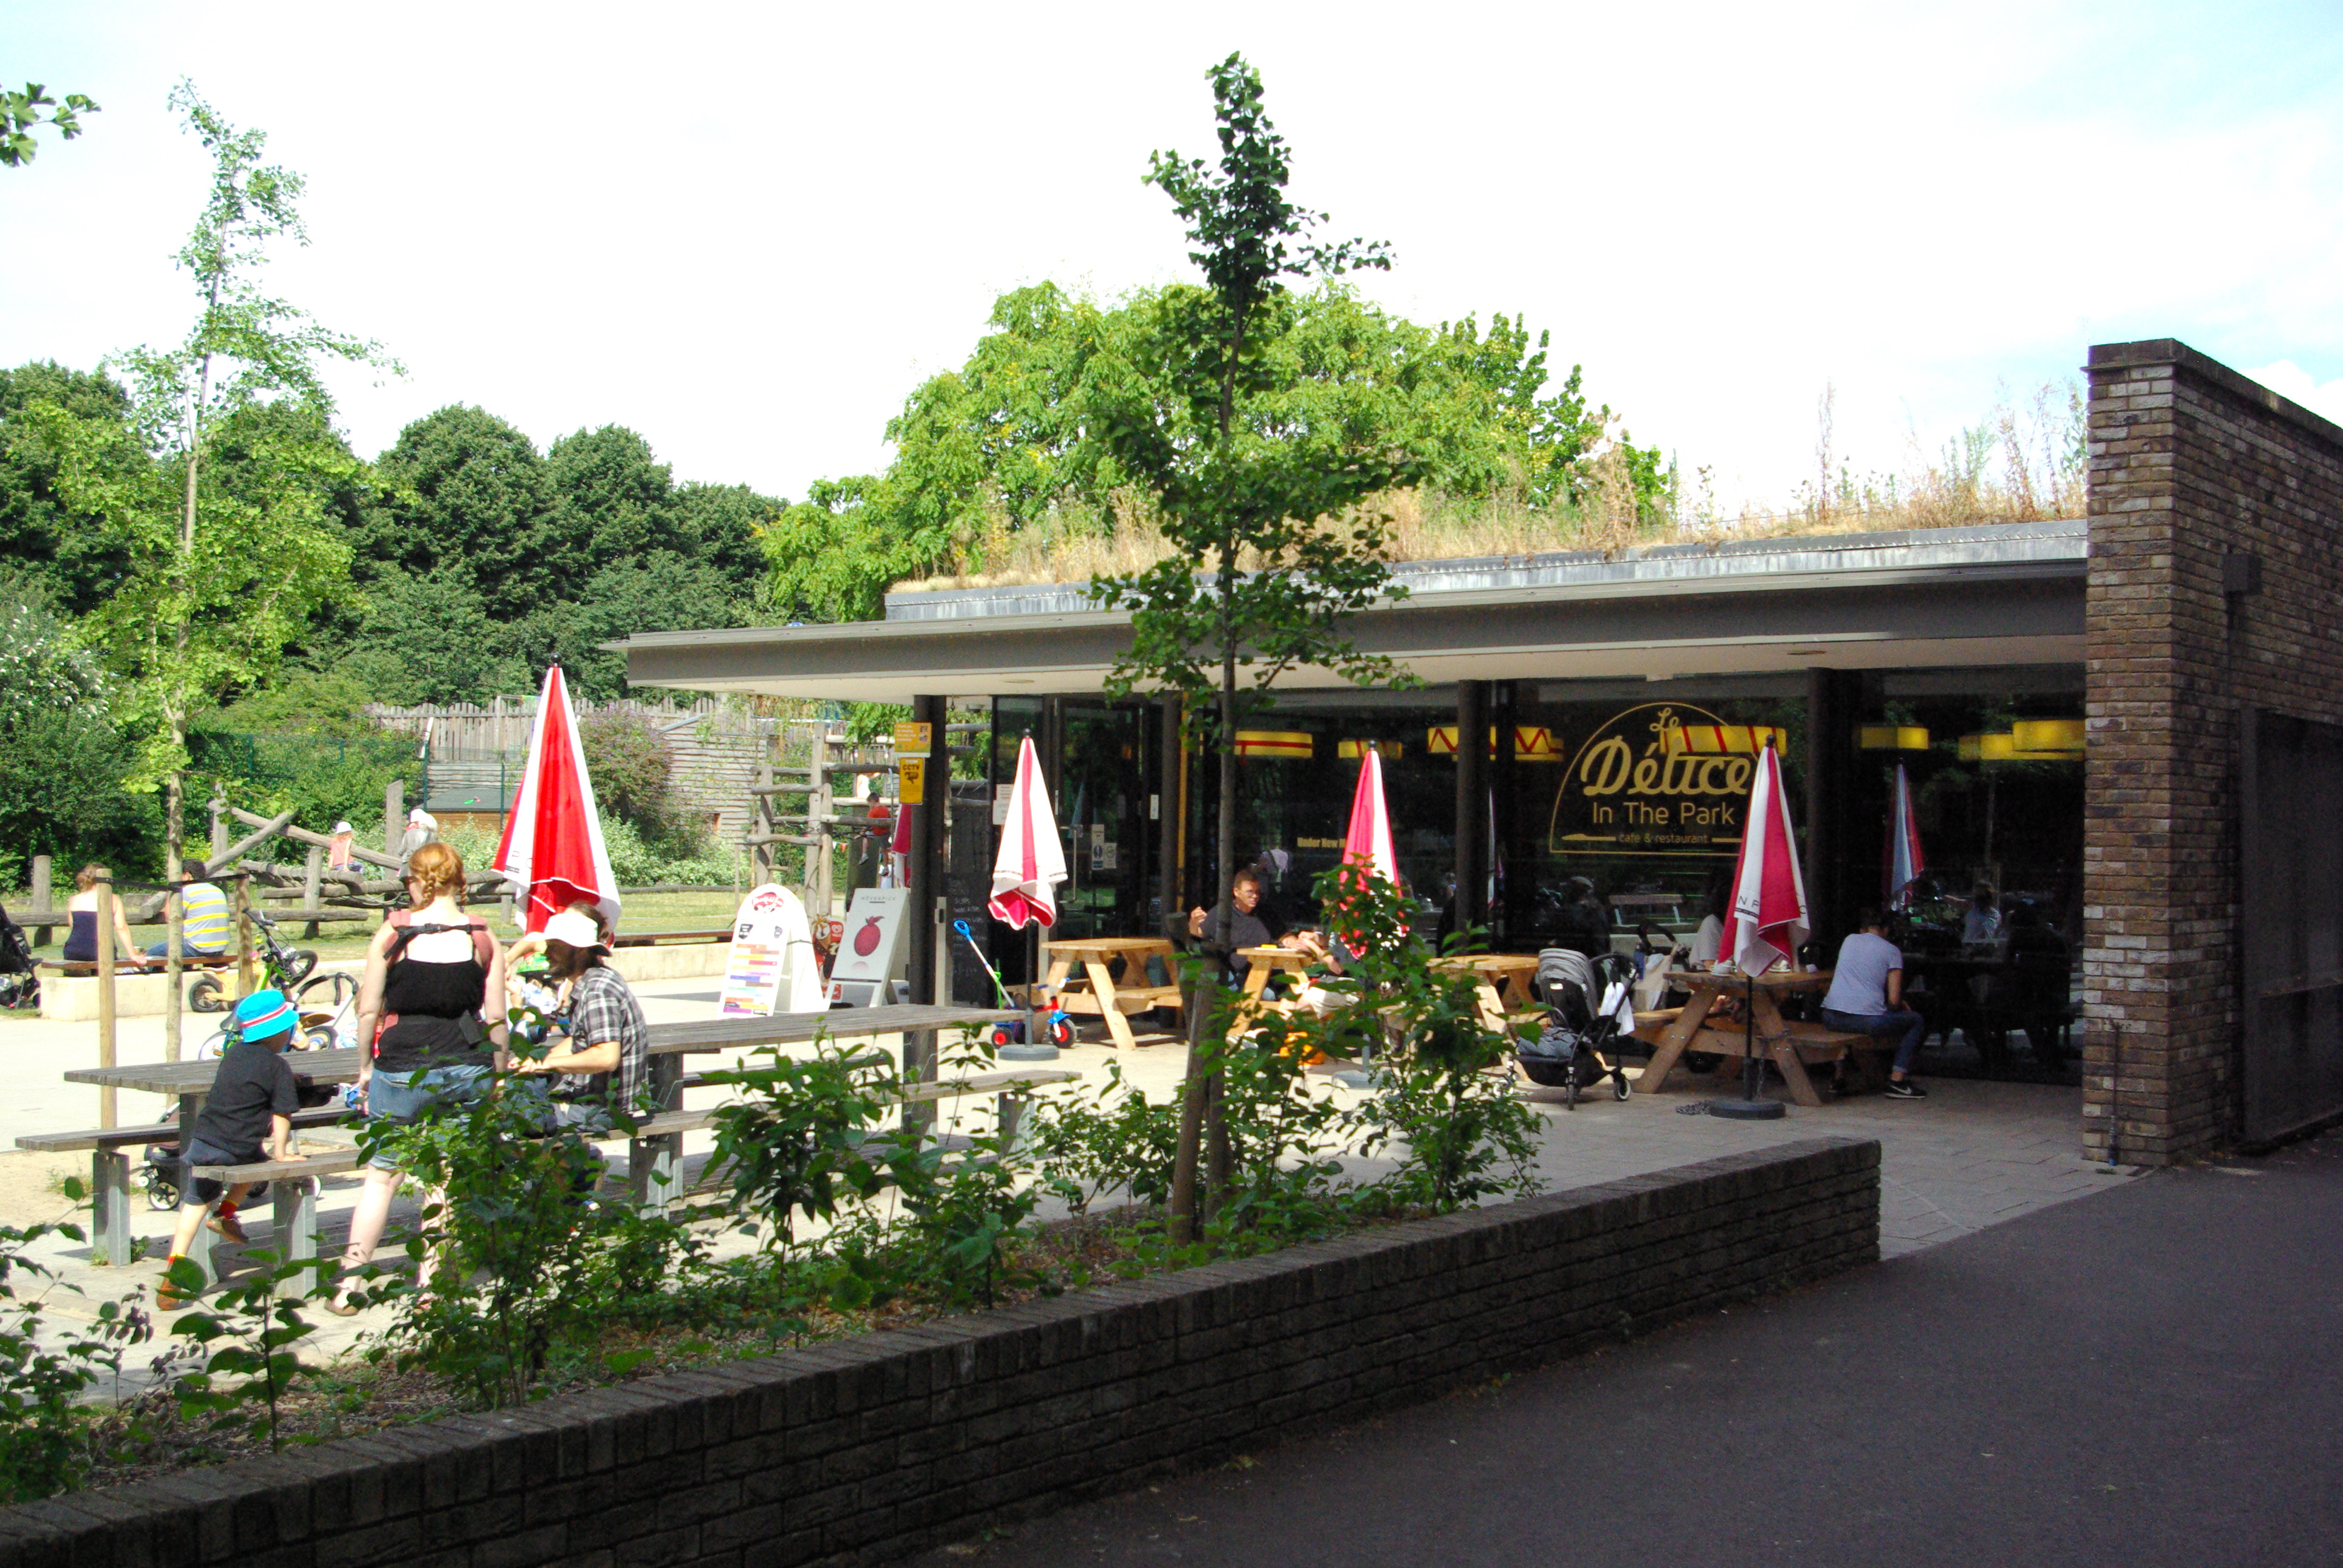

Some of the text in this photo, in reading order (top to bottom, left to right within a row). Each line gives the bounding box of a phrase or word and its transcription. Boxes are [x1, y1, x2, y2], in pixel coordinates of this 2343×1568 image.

[1650, 707, 1679, 732] Le
[1580, 735, 1751, 796] Délice
[1593, 802, 1735, 825] In The Park
[1644, 833, 1651, 843] &
[1655, 834, 1708, 843] restaurant
